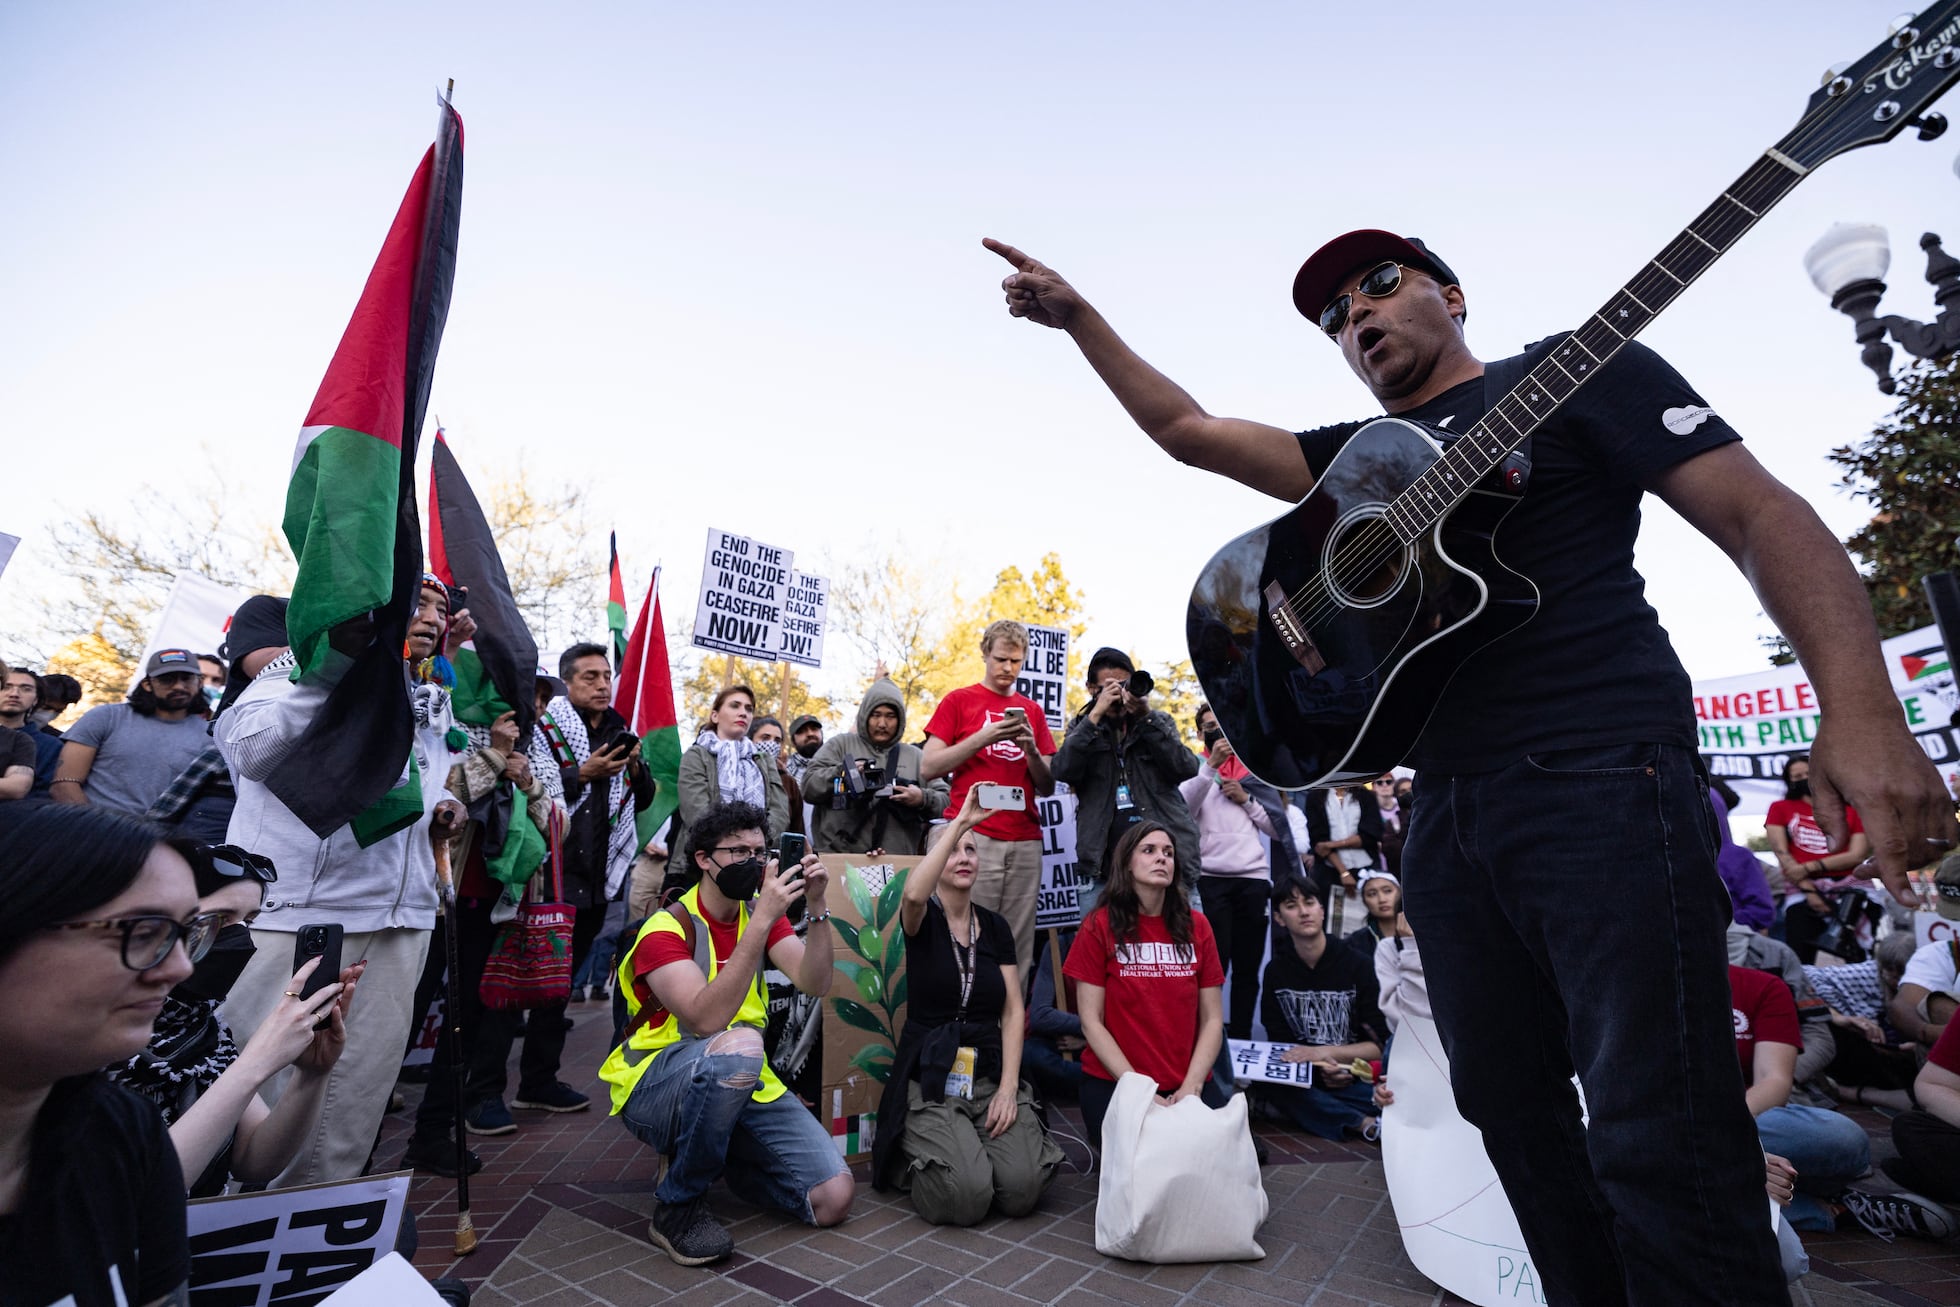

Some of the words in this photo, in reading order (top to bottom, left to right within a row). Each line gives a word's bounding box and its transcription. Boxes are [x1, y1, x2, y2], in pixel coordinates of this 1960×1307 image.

[721, 534, 749, 556] END
[757, 545, 782, 565] THE
[711, 550, 786, 586] GENOCIDE
[718, 571, 734, 590] IN
[738, 577, 775, 601] GAZA
[800, 575, 820, 591] THE
[705, 590, 780, 623] CEASEFIRE
[786, 601, 816, 618] GAZA
[788, 587, 824, 606] OCIDE
[708, 612, 768, 648] NOW!
[783, 617, 821, 637] SEFIRE
[1028, 628, 1066, 651] ESTINE
[781, 632, 812, 657] OW!
[1046, 650, 1064, 676] BE
[1016, 677, 1062, 716] REE!
[1693, 683, 1815, 720] ANGELE
[1700, 725, 1744, 748] ITH
[1711, 755, 1753, 776] AID
[1040, 800, 1064, 827] ND
[1115, 943, 1194, 964] NUHW
[268, 1199, 388, 1307] PA
